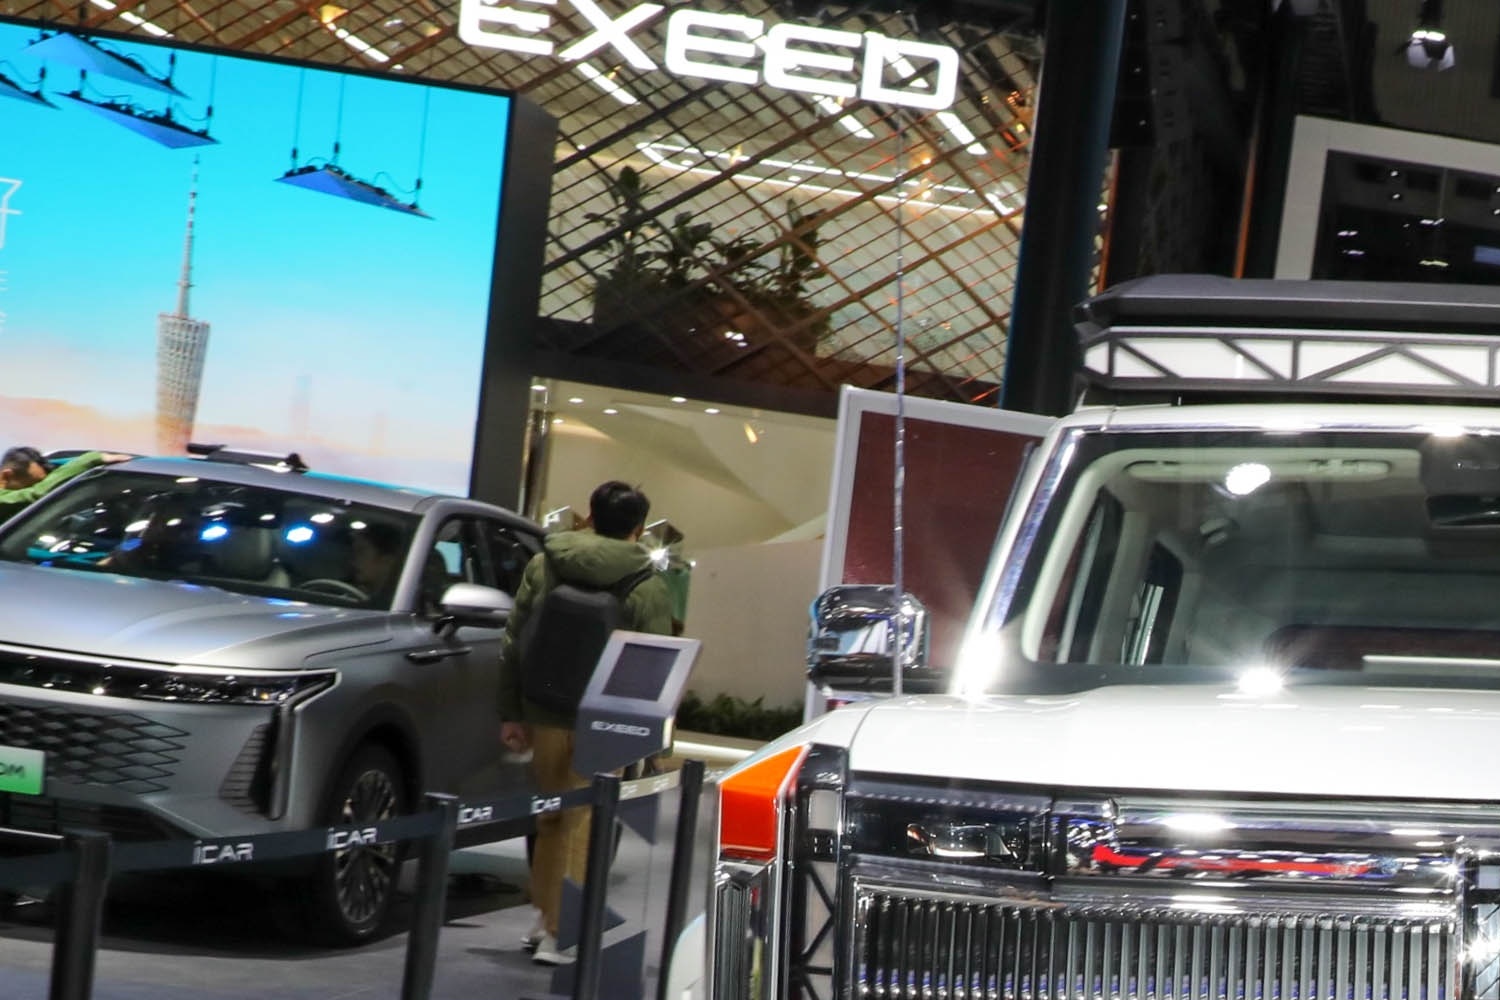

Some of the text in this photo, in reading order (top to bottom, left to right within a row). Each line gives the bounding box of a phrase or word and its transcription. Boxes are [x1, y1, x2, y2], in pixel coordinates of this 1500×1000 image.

[458, 0, 959, 111] EXEED
[591, 720, 650, 737] EXEED
[459, 804, 492, 823] iCAR
[530, 796, 561, 814] iCAR
[326, 828, 377, 850] iCAR
[193, 840, 254, 865] iCAR
